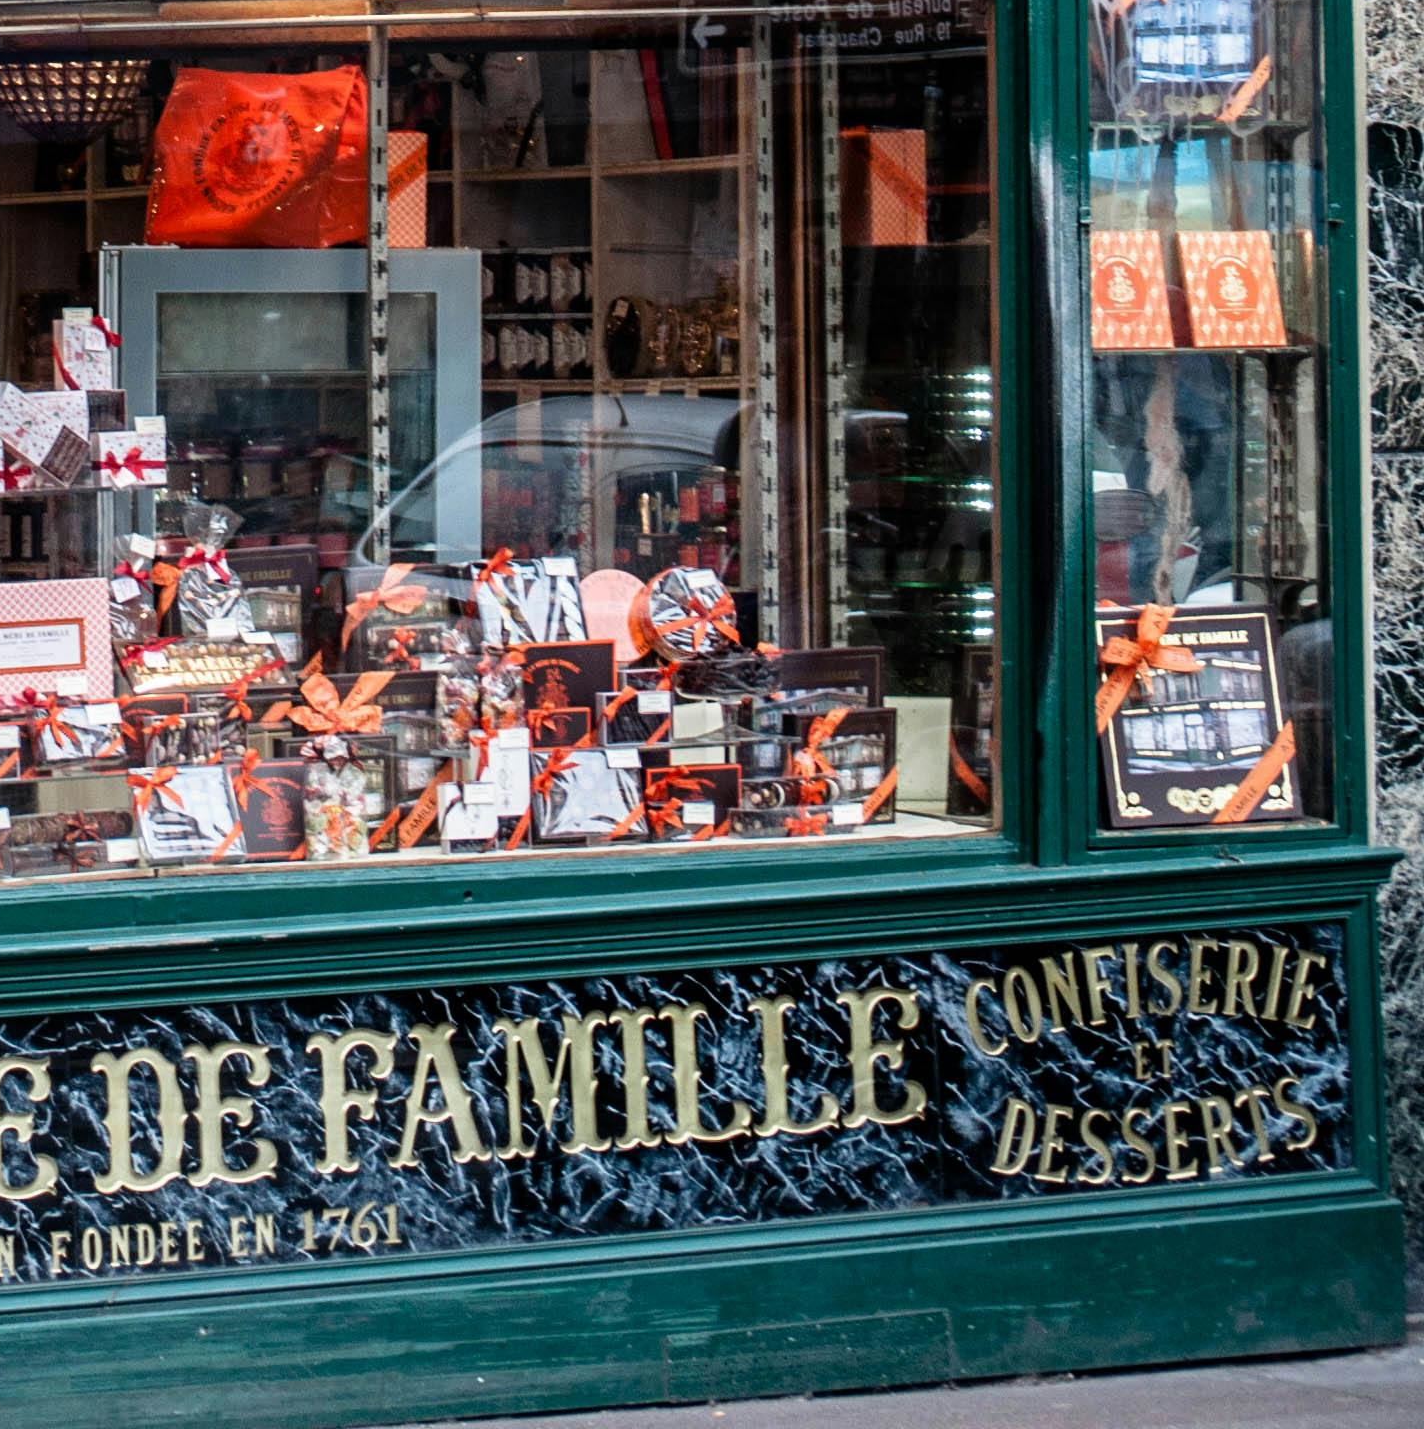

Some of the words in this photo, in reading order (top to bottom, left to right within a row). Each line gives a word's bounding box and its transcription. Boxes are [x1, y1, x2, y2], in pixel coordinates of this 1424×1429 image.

[965, 937, 1326, 1057] CONFISERIE
[89, 1041, 279, 1196] DE
[305, 986, 929, 1176] FAMILLE
[1134, 1039, 1175, 1081] ET
[989, 1076, 1319, 1186] DESSERTS
[229, 1211, 277, 1258] EN
[301, 1204, 403, 1252] 1761
